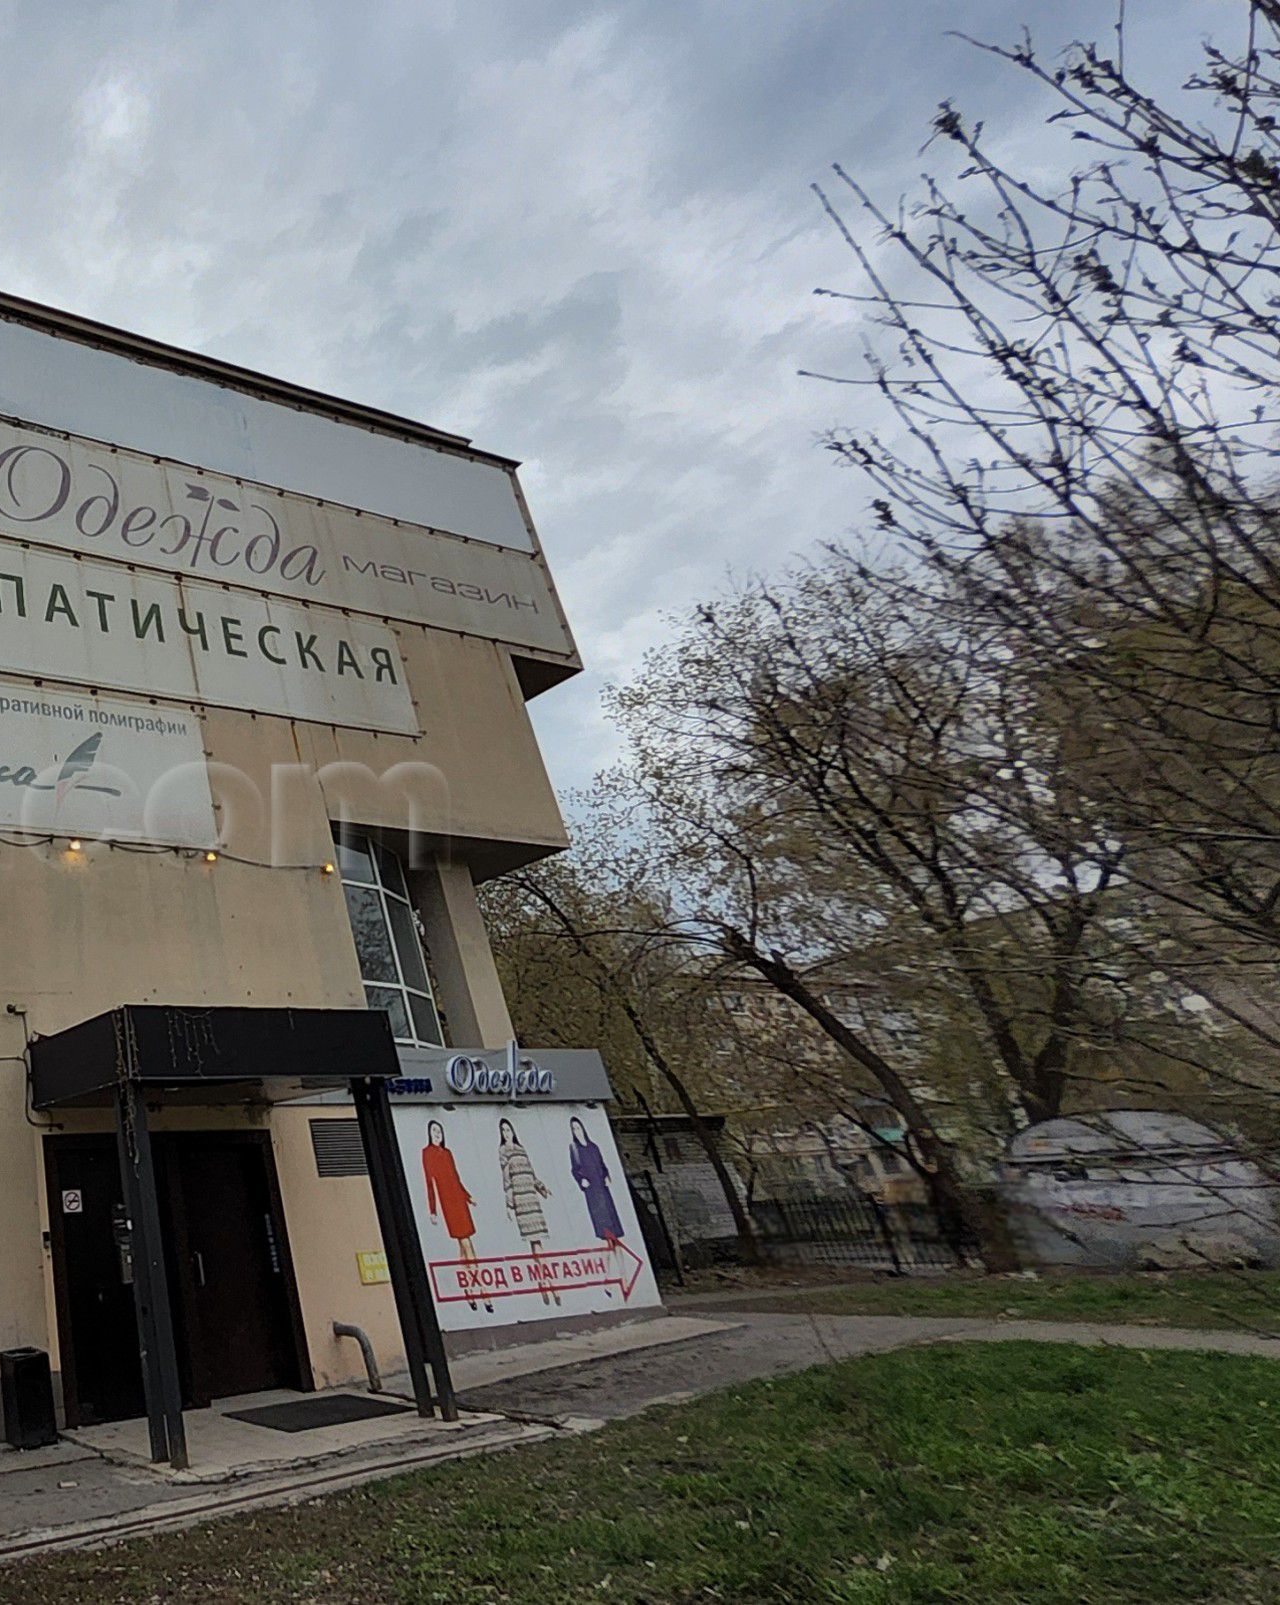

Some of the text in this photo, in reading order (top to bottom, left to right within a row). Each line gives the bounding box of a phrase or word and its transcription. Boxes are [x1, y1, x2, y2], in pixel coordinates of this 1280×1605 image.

[342, 554, 539, 615] магазин
[89, 709, 188, 736] полиграфии
[446, 1040, 556, 1100] Одежда
[456, 1256, 607, 1290] ВХОД В МАГАЗИН
